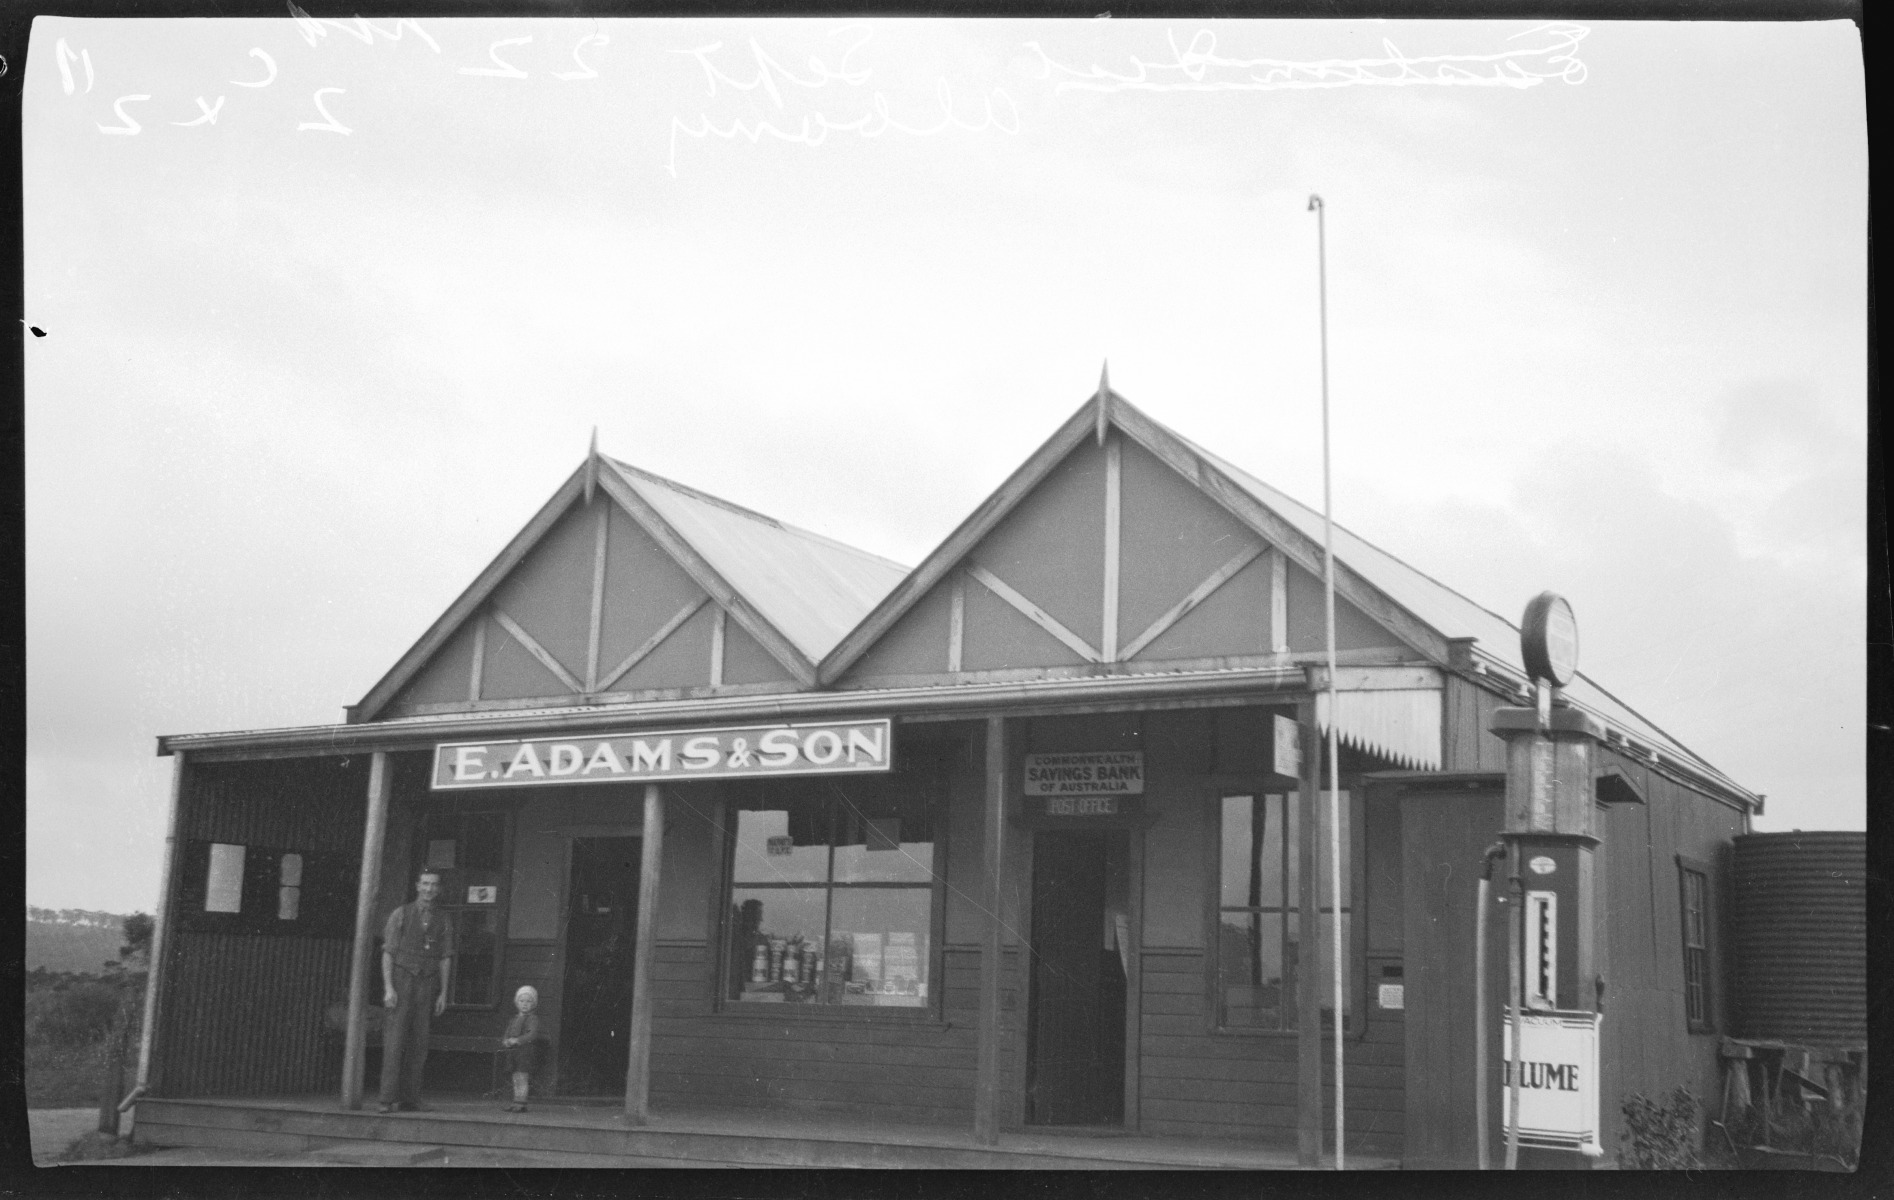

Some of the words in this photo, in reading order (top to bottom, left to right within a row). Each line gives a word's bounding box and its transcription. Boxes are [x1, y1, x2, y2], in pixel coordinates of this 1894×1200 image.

[502, 737, 721, 778] ADAMS
[727, 738, 752, 770] &
[758, 727, 884, 768] SON
[1035, 754, 1135, 766] COMMONWEALTH
[1029, 767, 1093, 782] SAVINGS
[1098, 766, 1142, 780] BANK
[1039, 783, 1057, 793] OF
[1060, 782, 1129, 793] AUSTRALIA
